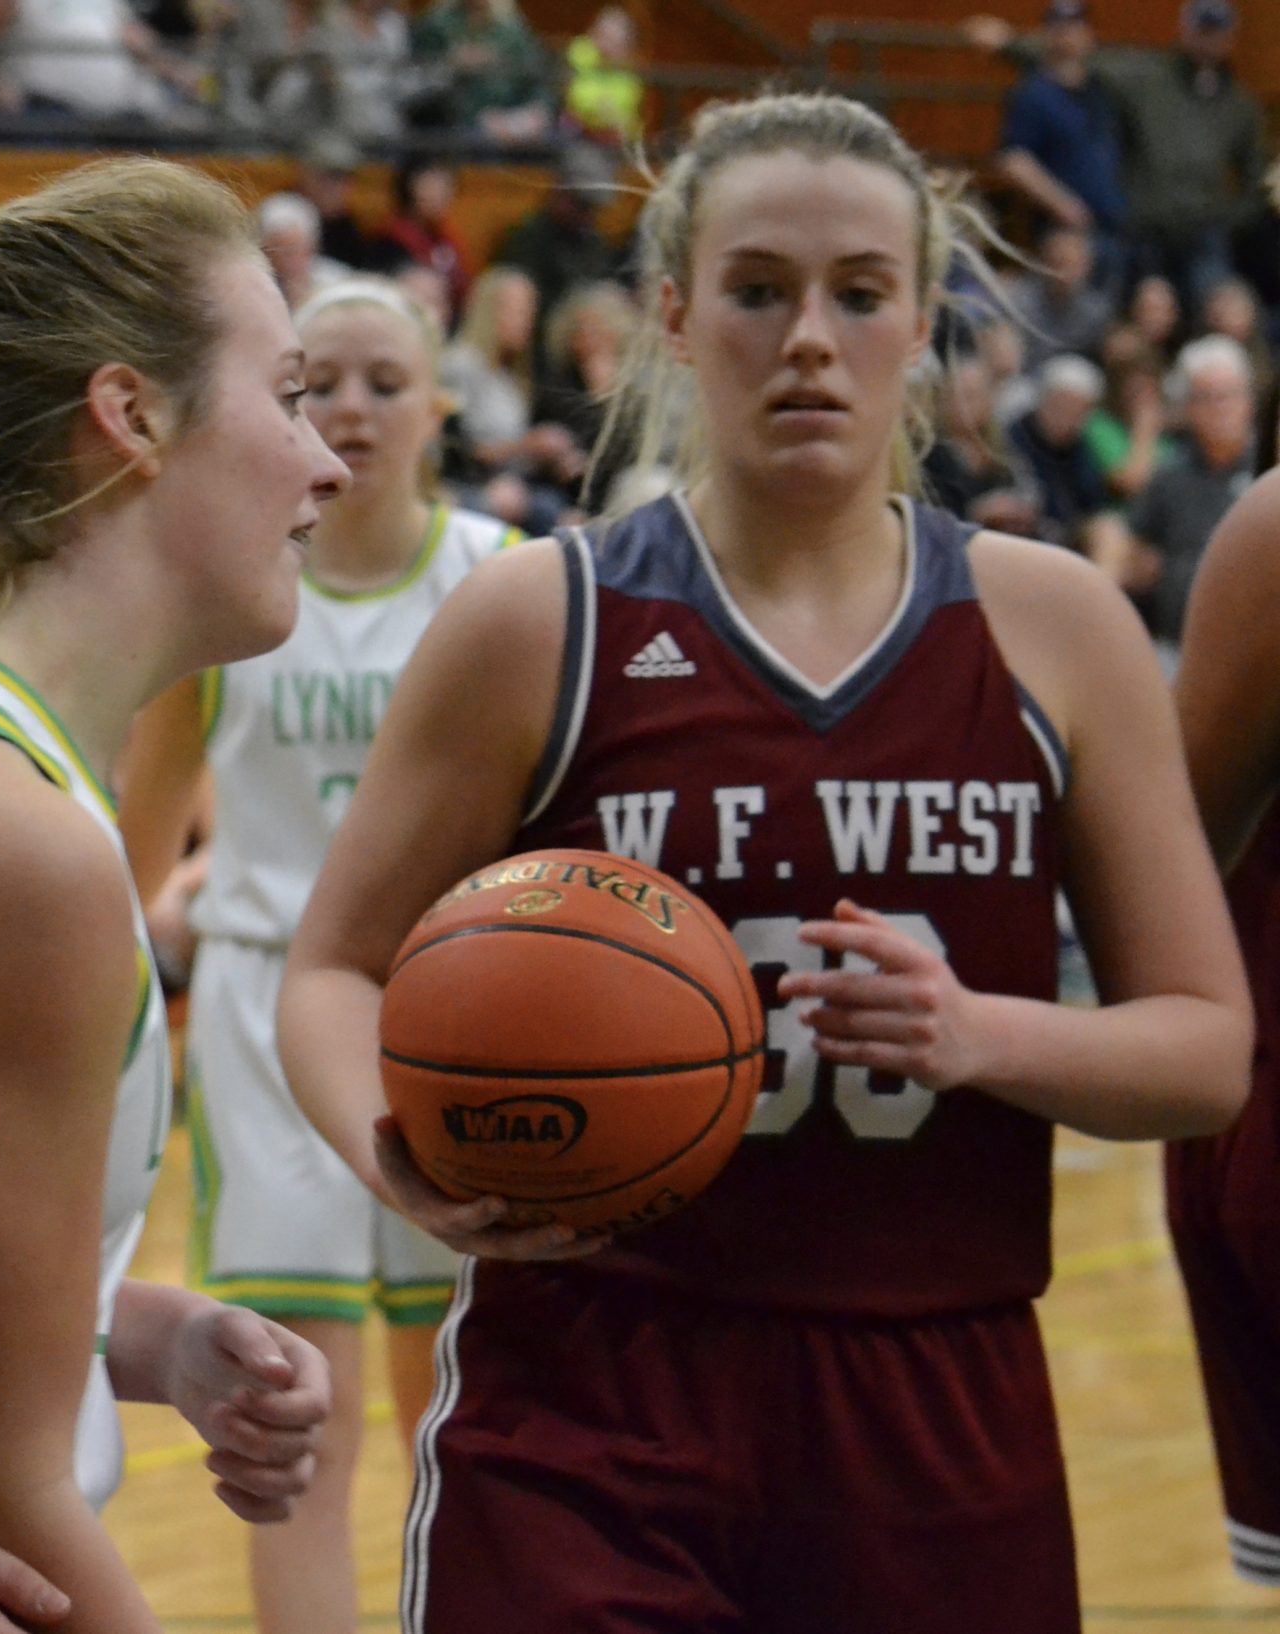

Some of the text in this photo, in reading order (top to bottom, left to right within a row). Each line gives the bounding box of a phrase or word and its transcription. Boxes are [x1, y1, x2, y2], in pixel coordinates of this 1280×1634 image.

[623, 660, 696, 678] adidas
[816, 780, 1040, 876] WEST
[442, 1103, 564, 1145] WIAA
